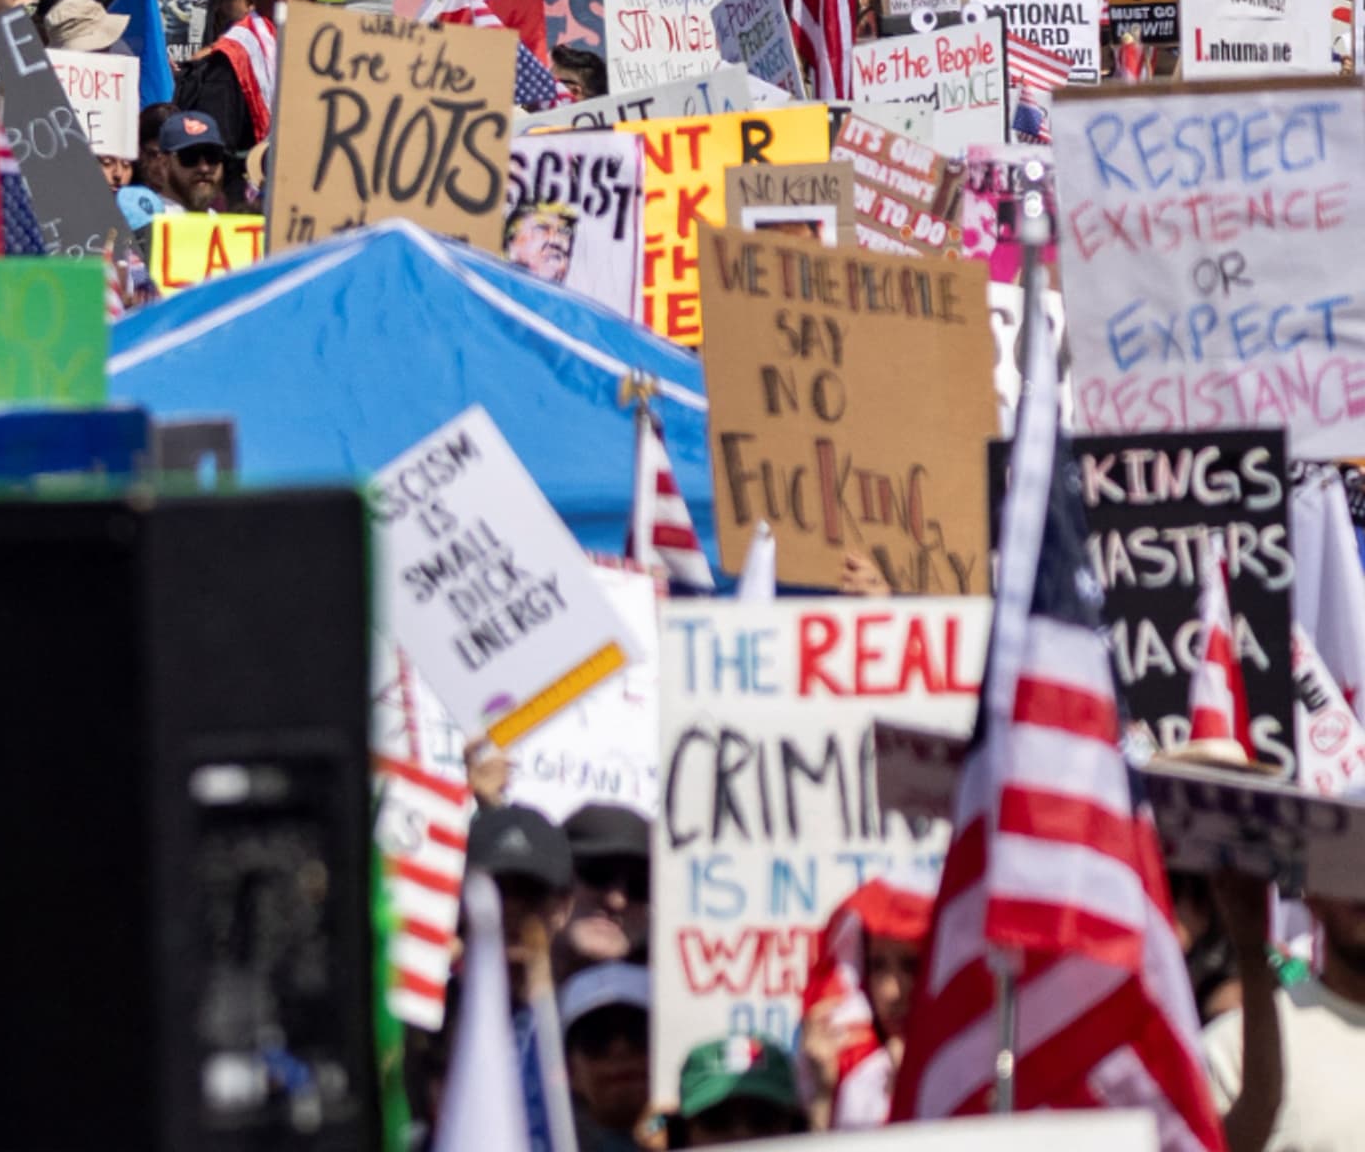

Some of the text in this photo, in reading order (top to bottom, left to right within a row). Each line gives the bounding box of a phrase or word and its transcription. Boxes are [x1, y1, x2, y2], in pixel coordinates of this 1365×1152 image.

[1110, 6, 1176, 20] MUST GO
[409, 48, 476, 92] the
[855, 27, 996, 87] We the People
[313, 87, 507, 215] RIOTS
[1085, 102, 1345, 194] RESPECT
[739, 174, 777, 202] NO
[1072, 184, 1352, 261] EXISTENCE
[774, 246, 841, 302] THE
[1192, 250, 1254, 296] OR
[774, 308, 847, 367] SAY
[1106, 294, 1354, 372] EXPECT
[760, 364, 847, 424] NO
[1084, 445, 1284, 509] KINGS
[401, 520, 506, 606] SMALL
[453, 576, 572, 673] ENERGY
[668, 614, 981, 698] THE REAL
